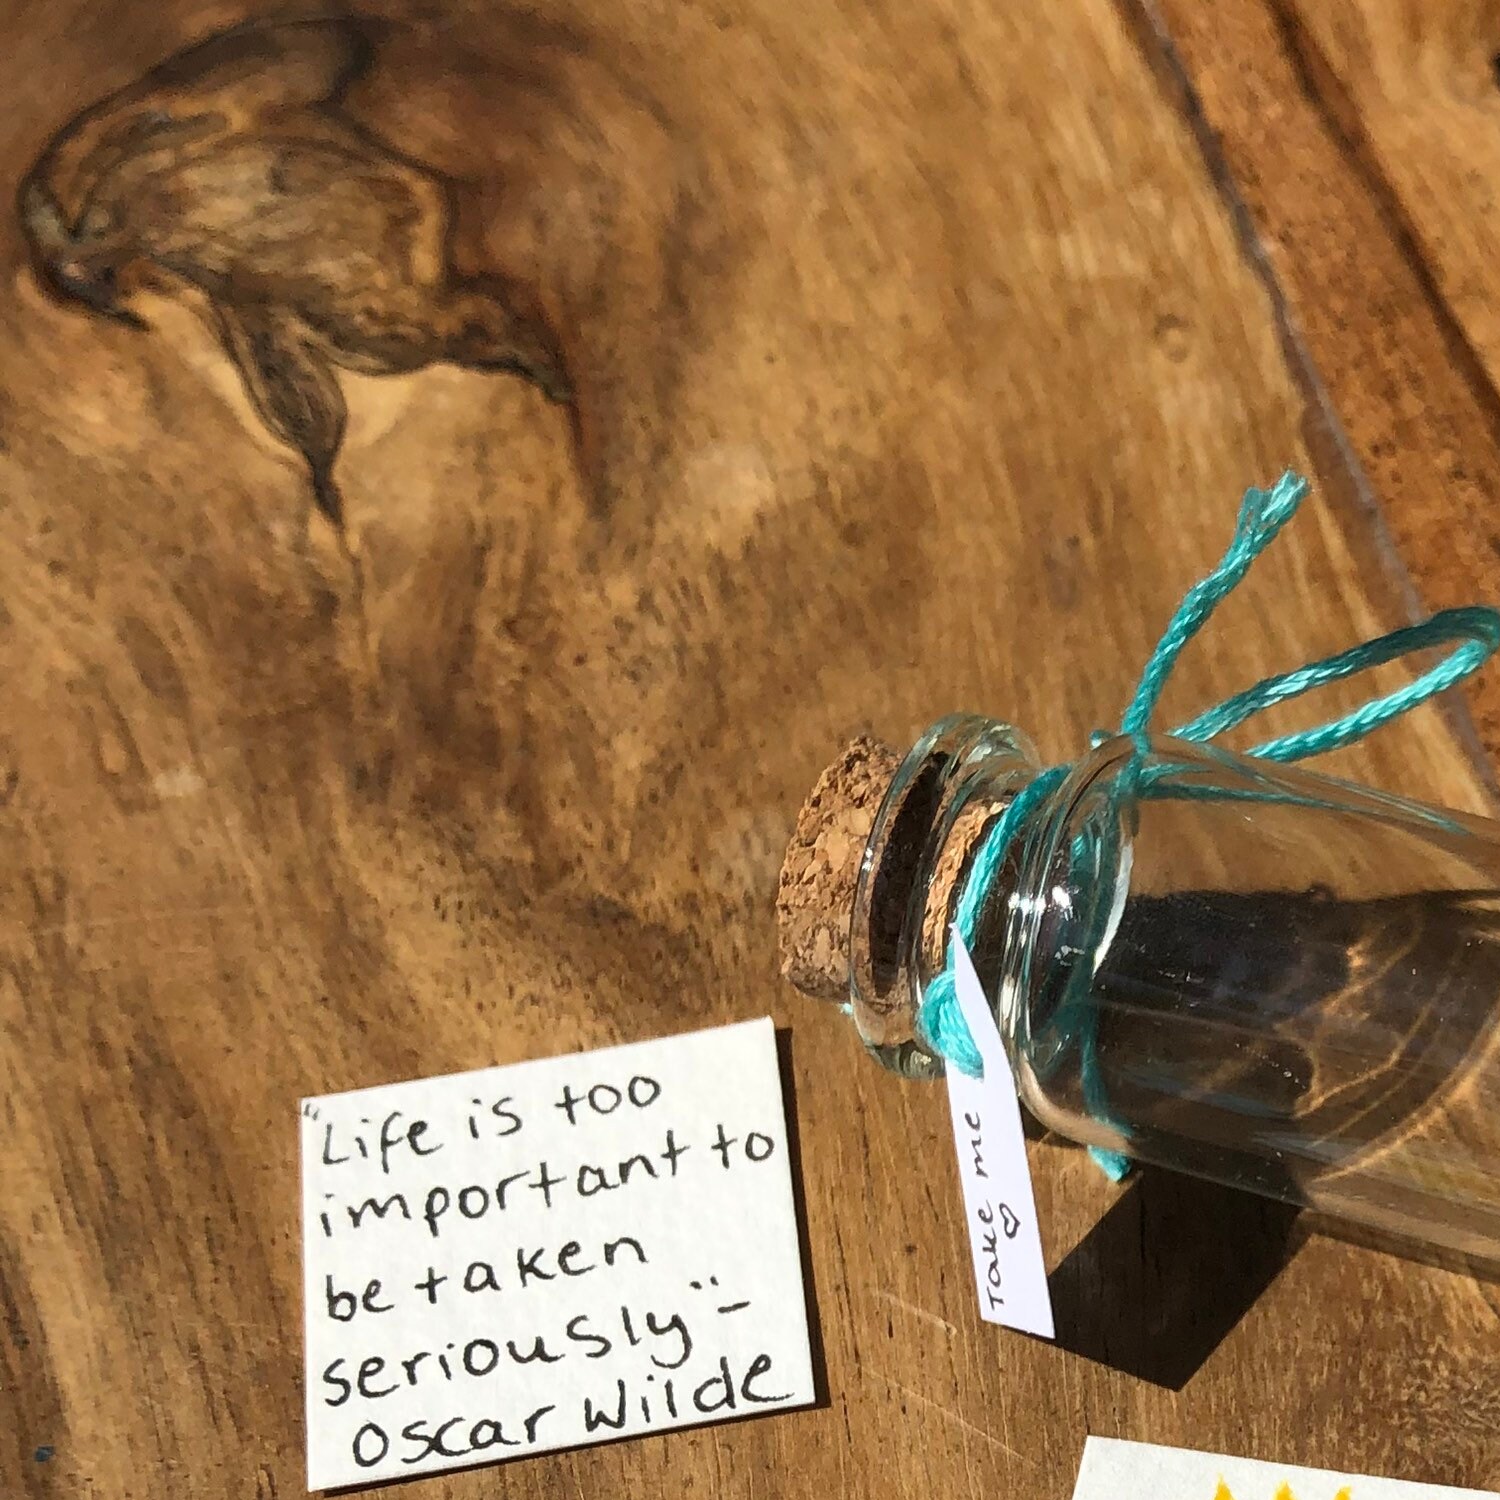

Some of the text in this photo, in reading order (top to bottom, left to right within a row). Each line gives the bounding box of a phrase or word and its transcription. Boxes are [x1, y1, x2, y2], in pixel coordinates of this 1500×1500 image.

[467, 1097, 522, 1138] is
[554, 1075, 661, 1125] too
[319, 1124, 775, 1237] important to
[965, 1111, 1005, 1310] Take me
[325, 1236, 650, 1322] be taken
